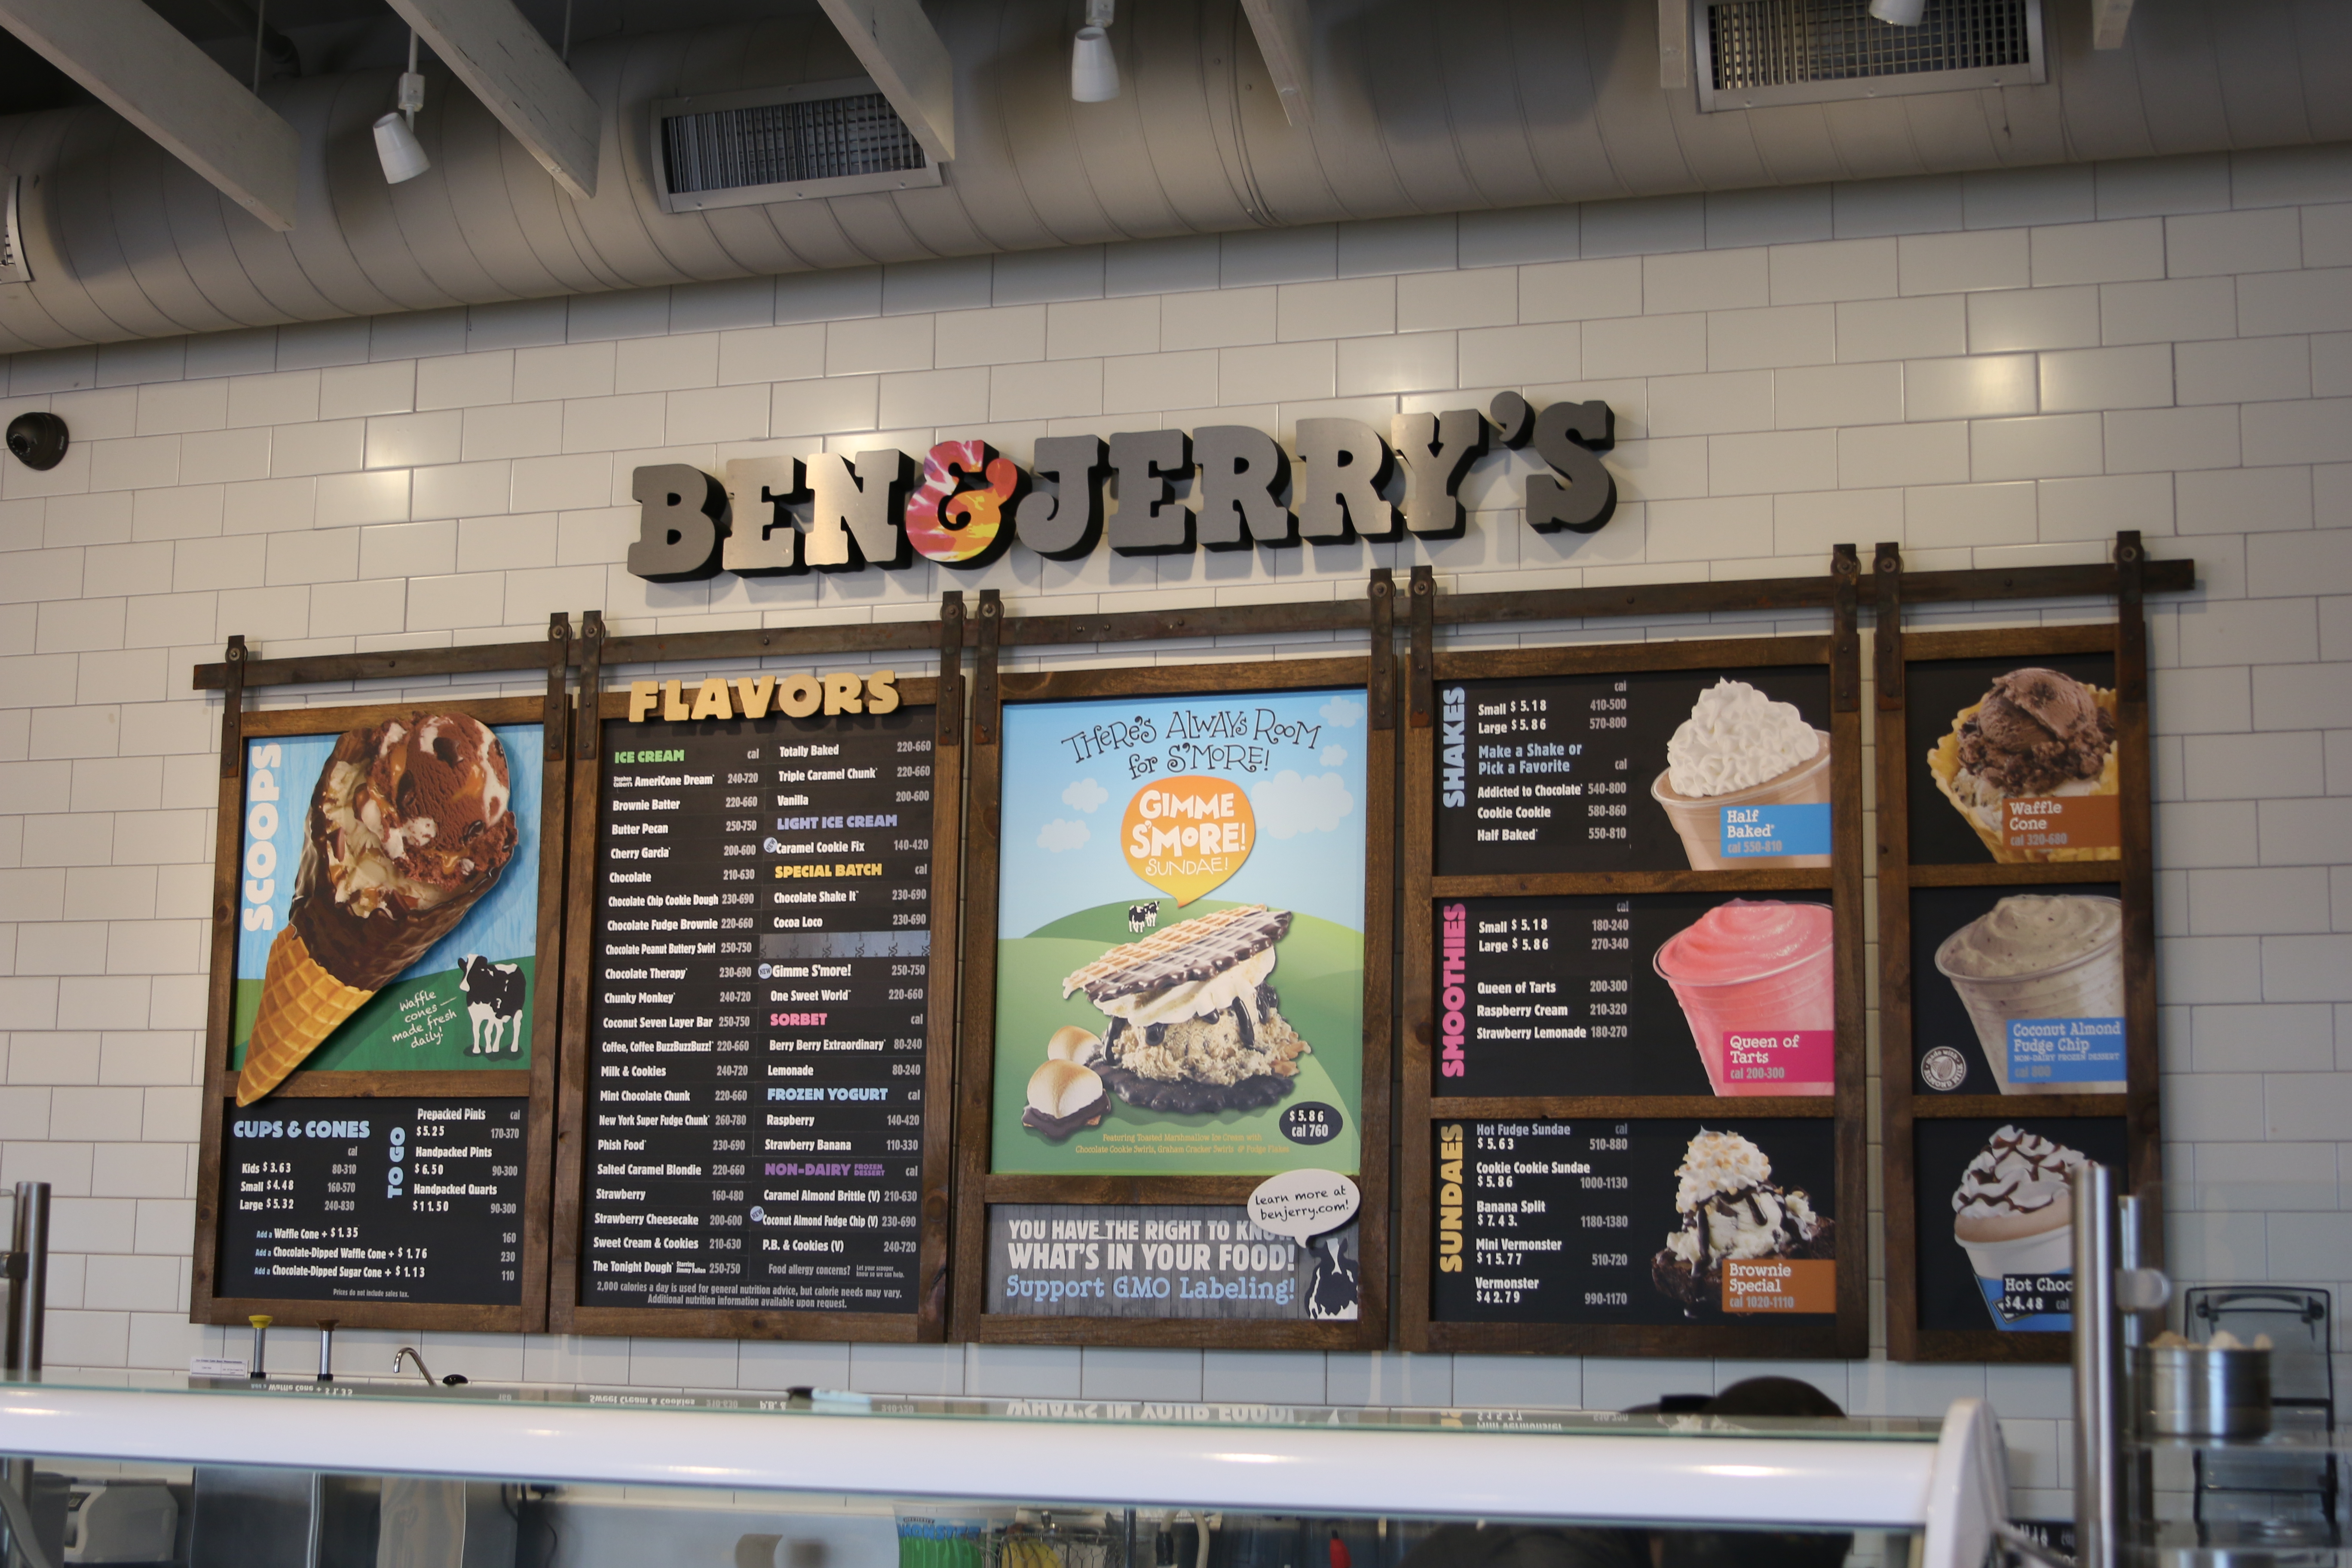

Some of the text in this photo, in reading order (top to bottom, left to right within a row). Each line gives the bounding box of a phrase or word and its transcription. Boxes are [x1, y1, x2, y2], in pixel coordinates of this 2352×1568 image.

[627, 390, 1617, 581] BEN & JERRY'S
[629, 670, 899, 722] FLAVORS
[1478, 703, 1507, 715] Small
[1590, 698, 1626, 710] 410-500
[1443, 686, 1465, 807] SHAKES
[615, 749, 759, 763] ICE CREAM cal
[1129, 753, 1158, 779] for
[634, 775, 682, 787] AmeriCone
[728, 772, 758, 784] 240-720
[1139, 790, 1234, 819] GIMME
[2010, 801, 2062, 816] Waffle
[777, 815, 897, 830] LIGHT ICE CREAM
[2009, 817, 2047, 831] Cone
[243, 742, 282, 931] SCOOPS
[2010, 835, 2024, 846] cal
[776, 839, 928, 854] Caramel Cookie Fix 140-420
[775, 863, 882, 879] SPECIAL BATCH
[1145, 858, 1228, 876] SUNDAE!
[608, 894, 754, 908] Chocolate Chip Cookie Dough 230-690
[772, 964, 925, 977] Gimme S'more! 250-750
[1442, 903, 1466, 1077] SMOOTHIES
[399, 990, 437, 1011] waffle
[405, 1004, 438, 1023] cones
[770, 1013, 923, 1026] SORBET cal
[392, 1009, 456, 1042] made fresh
[2013, 1021, 2121, 1036] Coconut Almond
[410, 1026, 442, 1048] daily!
[1730, 1034, 1800, 1050] Queen of
[2014, 1037, 2090, 1053] Fudge Chip
[1730, 1050, 1769, 1064] Tarts
[1730, 1066, 1785, 1079] cal 200-300
[768, 1087, 888, 1101] FROZEN YOGURT
[417, 1107, 486, 1121] Prepacked Pints
[234, 1120, 370, 1137] CUPS & CONES
[1292, 1124, 1329, 1137] cal 760
[242, 1163, 260, 1174] Kids
[332, 1164, 356, 1175] 80-310
[387, 1126, 405, 1198] TO GO
[765, 1163, 851, 1176] NON-DAIRY
[1256, 1185, 1346, 1205] learn more at
[1439, 1123, 1462, 1273] SUNDAES
[1261, 1199, 1348, 1221] benjerry.com!
[274, 1228, 299, 1239] Waffle
[301, 1228, 319, 1239] Cone
[1009, 1220, 1293, 1240] YOU HAVE THE RIGHT TO KN
[1008, 1243, 1295, 1271] WHAT'S IN YOUR FOOD!
[769, 1264, 850, 1275] Food allergy concerns?
[1729, 1264, 1792, 1277] Brownie
[597, 1281, 619, 1292] 2,000
[620, 1281, 647, 1292] calories
[656, 1282, 670, 1294] day
[671, 1283, 677, 1292] is
[680, 1283, 695, 1293] used
[698, 1283, 709, 1293] for
[711, 1283, 738, 1295] general
[740, 1284, 770, 1295] nutrition
[772, 1285, 798, 1297] advice,
[800, 1285, 812, 1296] but
[815, 1285, 839, 1296] calorie
[841, 1287, 863, 1297] needs
[865, 1288, 881, 1299] may
[883, 1288, 902, 1299] vary.
[1007, 1274, 1295, 1305] Support GMO Labeling!
[1475, 1277, 1539, 1289] Vermonster
[1729, 1279, 1782, 1294] Special
[2005, 1277, 2073, 1290] Hot Choc
[1585, 1292, 1627, 1305] 990-1170
[1729, 1296, 1743, 1308] cal
